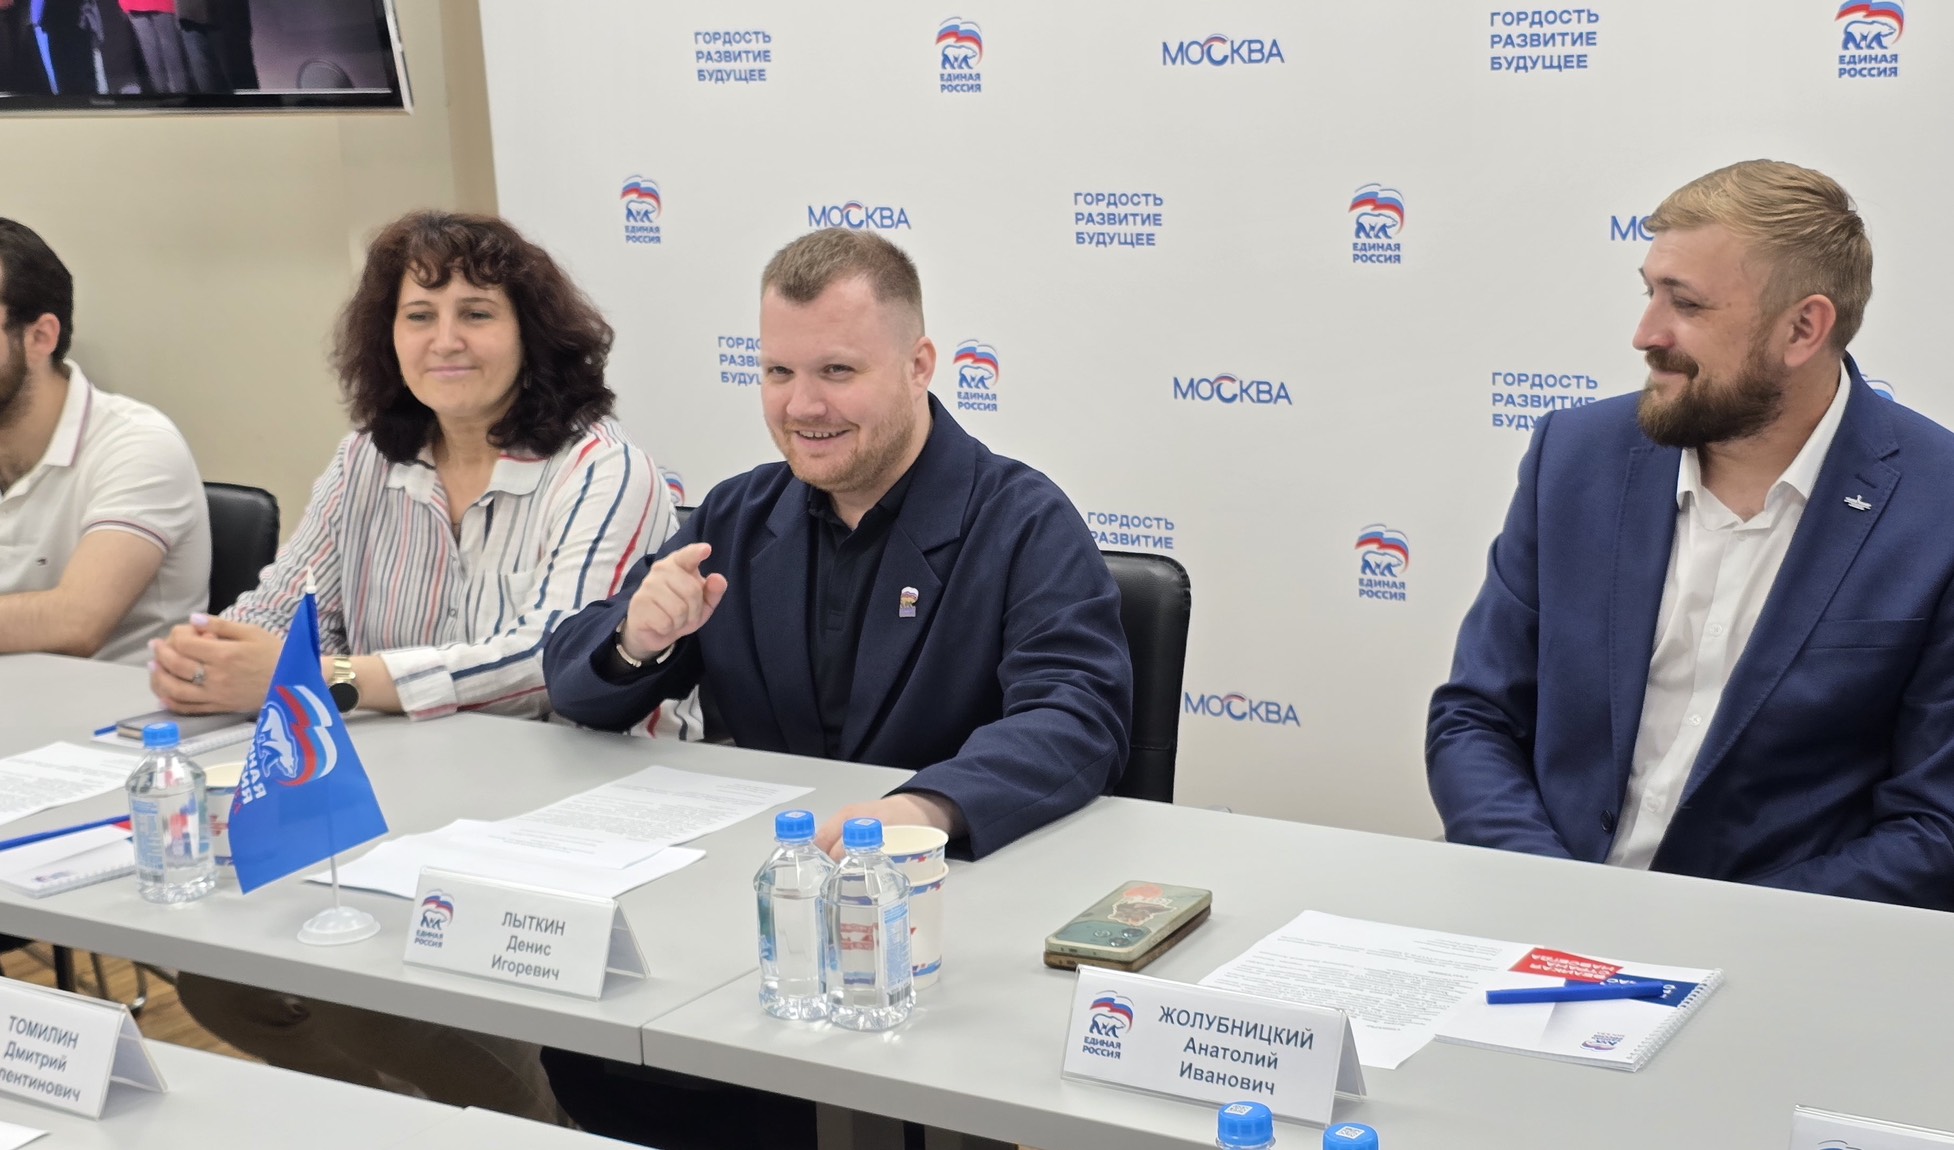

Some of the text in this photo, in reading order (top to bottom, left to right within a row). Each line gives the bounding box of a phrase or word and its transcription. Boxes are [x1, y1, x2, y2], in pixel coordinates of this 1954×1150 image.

[1491, 8, 1599, 30] ГОРДОСТЬ
[694, 30, 771, 46] ГОРДОСТЬ
[1491, 31, 1597, 51] РАЗВИТИЕ
[696, 50, 771, 64] РАЗВИТИЕ
[1161, 33, 1286, 67] МОСКВА
[1491, 53, 1588, 74] БУДУЩЕЕ
[1839, 53, 1898, 67] ЕДИНАЯ
[697, 68, 766, 84] БУДУЩЕЕ
[940, 72, 981, 83] ЕДИНАЯ
[1839, 67, 1898, 79] РОССИЯ
[940, 83, 981, 93] РОССИЯ
[1074, 191, 1163, 209] ГОРДОСТЬ
[807, 200, 912, 230] МОСКВА
[1075, 211, 1162, 227] РАЗВИТИЕ
[625, 224, 661, 236] ЕДИНАЯ
[626, 234, 661, 244] РОССИЯ
[1076, 231, 1155, 248] БУДУЩЕЕ
[1353, 242, 1400, 253] ЕДИНАЯ
[1353, 253, 1401, 264] РОССИЯ
[719, 353, 760, 367] РАЗВ
[720, 371, 761, 386] БУДУ
[1492, 372, 1598, 390] ГОРДОСТЬ
[957, 392, 997, 402] ЕДИНАЯ
[1173, 373, 1293, 405] МОСКВА
[958, 402, 997, 411] РОССИЯ
[1492, 413, 1536, 431] БУДУ
[1087, 511, 1175, 531] ГОРДОСТЬ
[1359, 578, 1405, 590] ЕДИНАЯ
[1359, 589, 1406, 601] РОССИЯ
[1184, 692, 1301, 728] МОСКВА
[502, 912, 565, 936] ЛЫТКИН
[416, 930, 444, 940] ЕДИНАЯ
[414, 938, 443, 949] РОССИЯ
[506, 935, 552, 956] Денис
[490, 954, 560, 980] Игоревич
[9, 1015, 80, 1050] ТОМИЛИН
[1159, 1005, 1313, 1051] ЖОЛУБНИЦКИЙ
[1083, 1036, 1122, 1050] ЕДИНАЯ
[3, 1041, 68, 1073] Дмитрий
[1082, 1045, 1121, 1060] РОССИЯ
[1182, 1036, 1279, 1070] Анатолий
[0, 1066, 81, 1103] лентинович
[1179, 1061, 1276, 1095] Иванович
